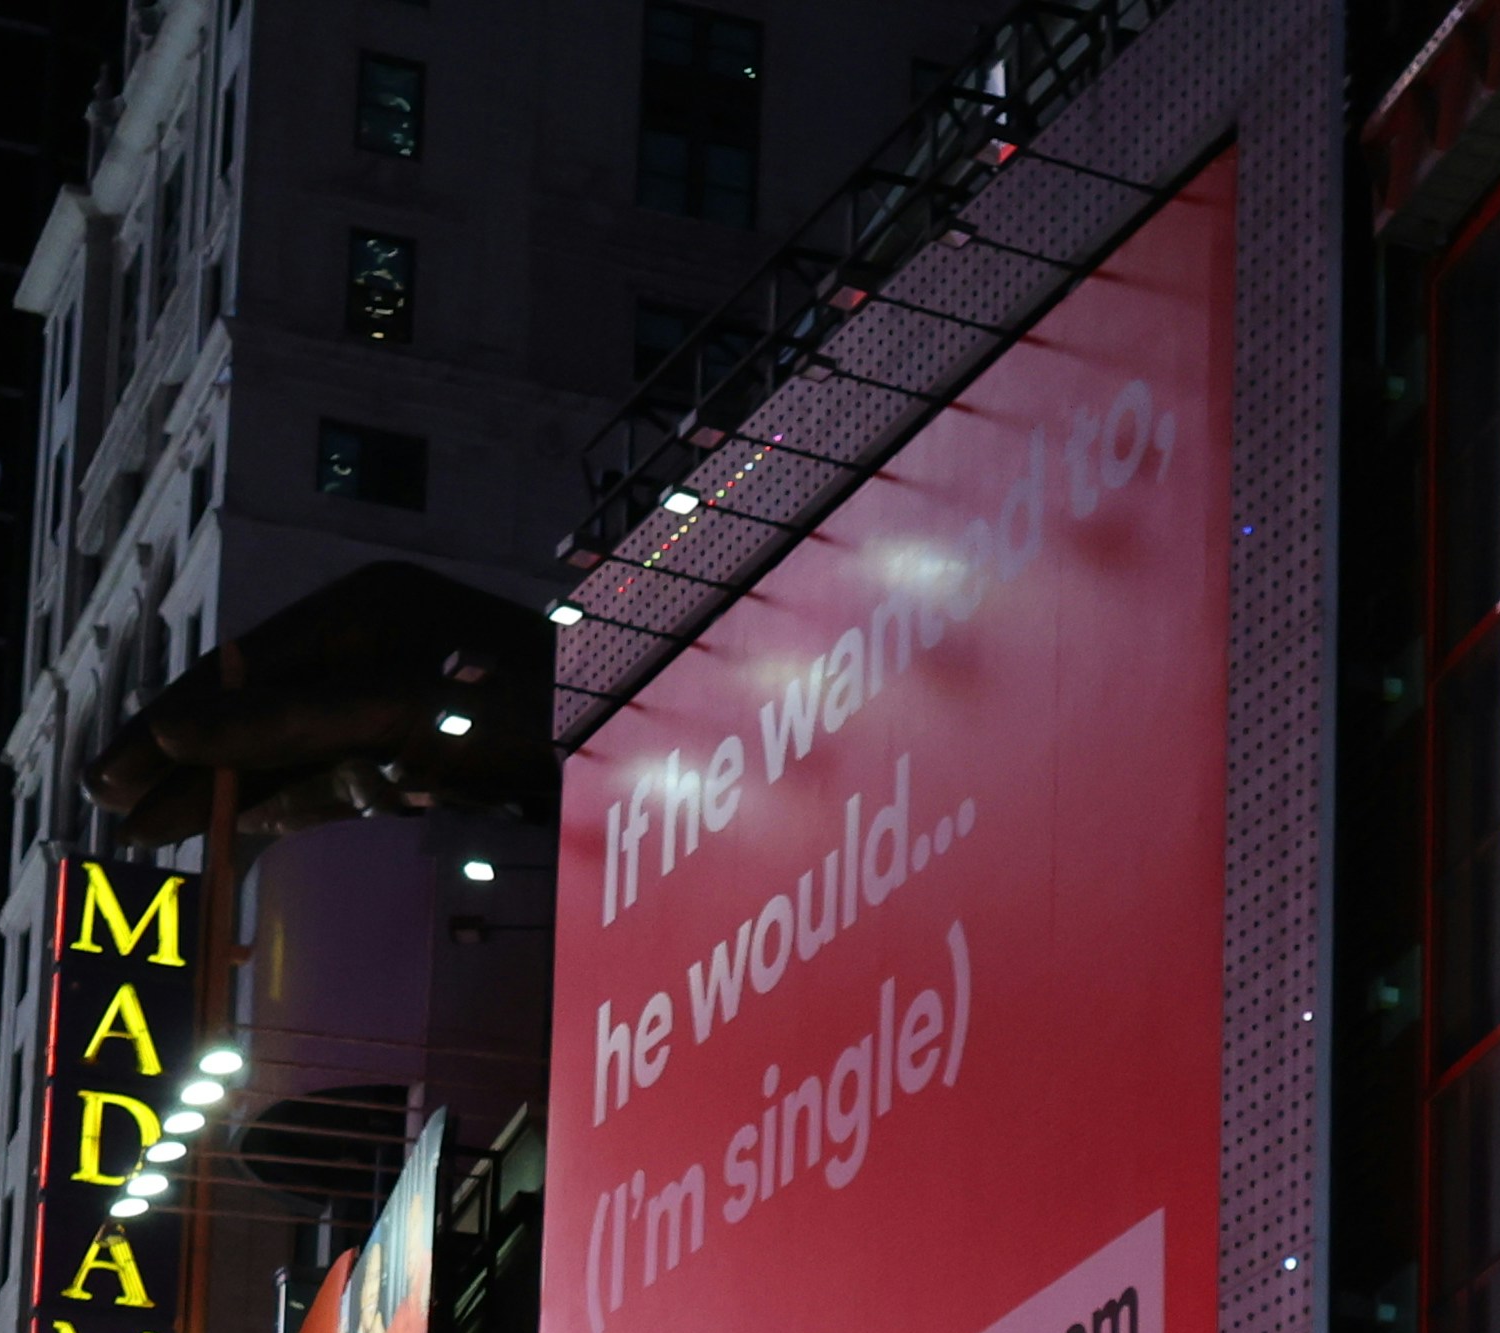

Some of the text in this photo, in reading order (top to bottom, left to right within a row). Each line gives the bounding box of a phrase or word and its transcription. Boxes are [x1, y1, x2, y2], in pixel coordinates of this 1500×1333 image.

[601, 378, 1178, 928] If he wanted to,
[593, 753, 977, 1127] he would...
[723, 918, 972, 1224] single)
